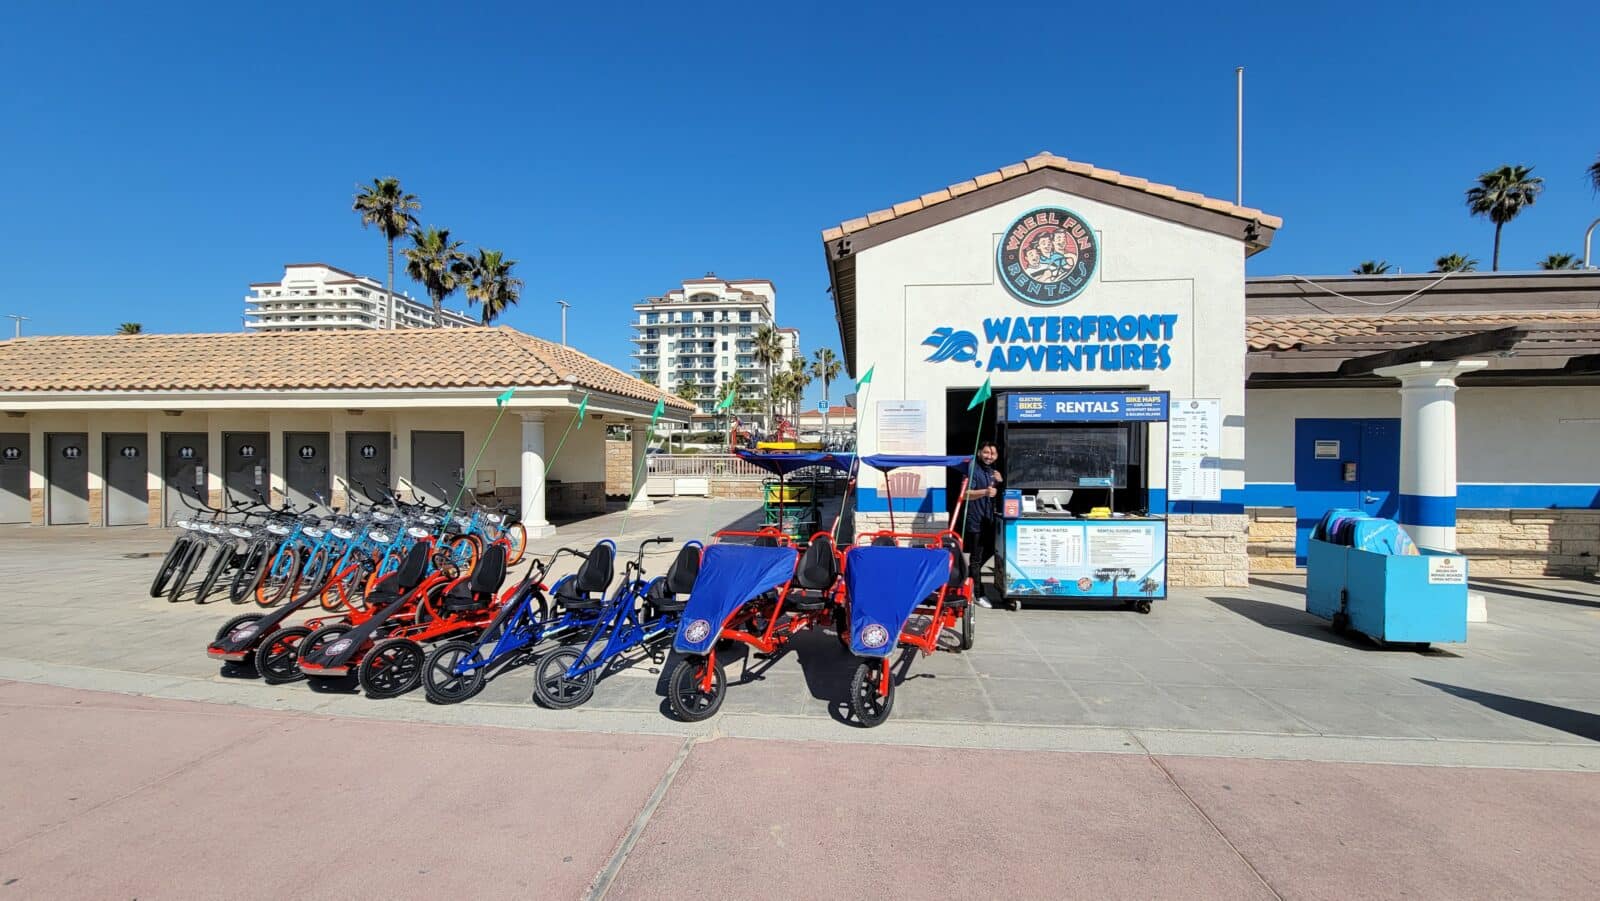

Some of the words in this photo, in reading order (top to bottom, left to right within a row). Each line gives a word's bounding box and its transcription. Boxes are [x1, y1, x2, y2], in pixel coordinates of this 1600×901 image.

[1006, 212, 1060, 251] WHEEL
[1062, 217, 1092, 251] FUN
[1007, 261, 1088, 297] RENTALS
[983, 314, 1178, 343] WATERFRONT
[986, 343, 1172, 373] ADVENTURES
[1019, 402, 1043, 410] BIKES
[1055, 401, 1120, 414] RENTALS
